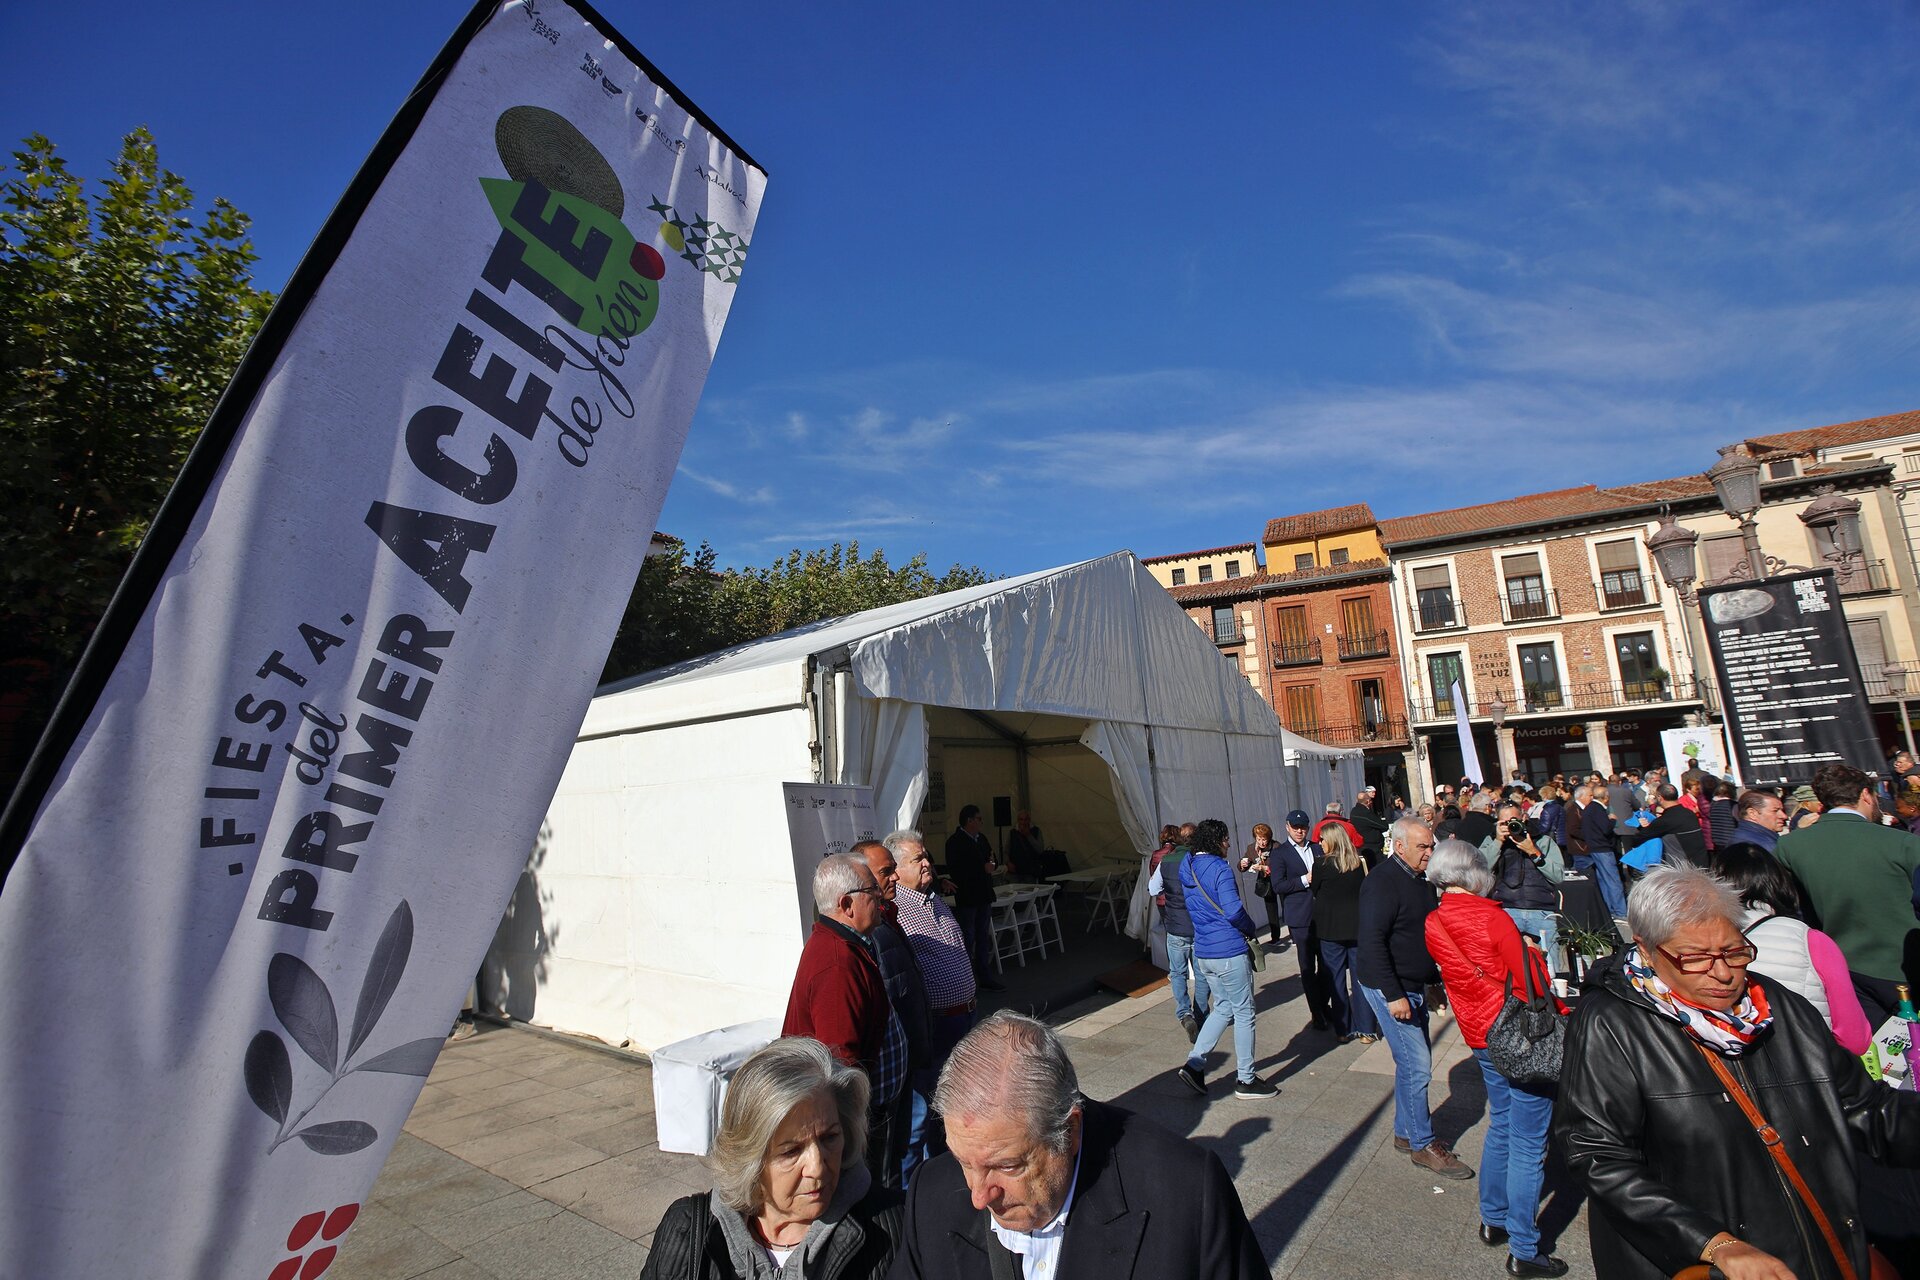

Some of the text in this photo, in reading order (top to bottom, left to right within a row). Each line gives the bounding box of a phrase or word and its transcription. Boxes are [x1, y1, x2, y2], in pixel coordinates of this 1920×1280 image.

[364, 176, 613, 615] ACEITE
[543, 280, 648, 468] de Jaén
[1478, 652, 1504, 660] PSICO
[1491, 669, 1510, 677] LUZ
[285, 701, 348, 785] del
[1516, 726, 1567, 738] Madrid
[256, 613, 455, 932] PRIMER
[1881, 1036, 1912, 1050] ACEIT
